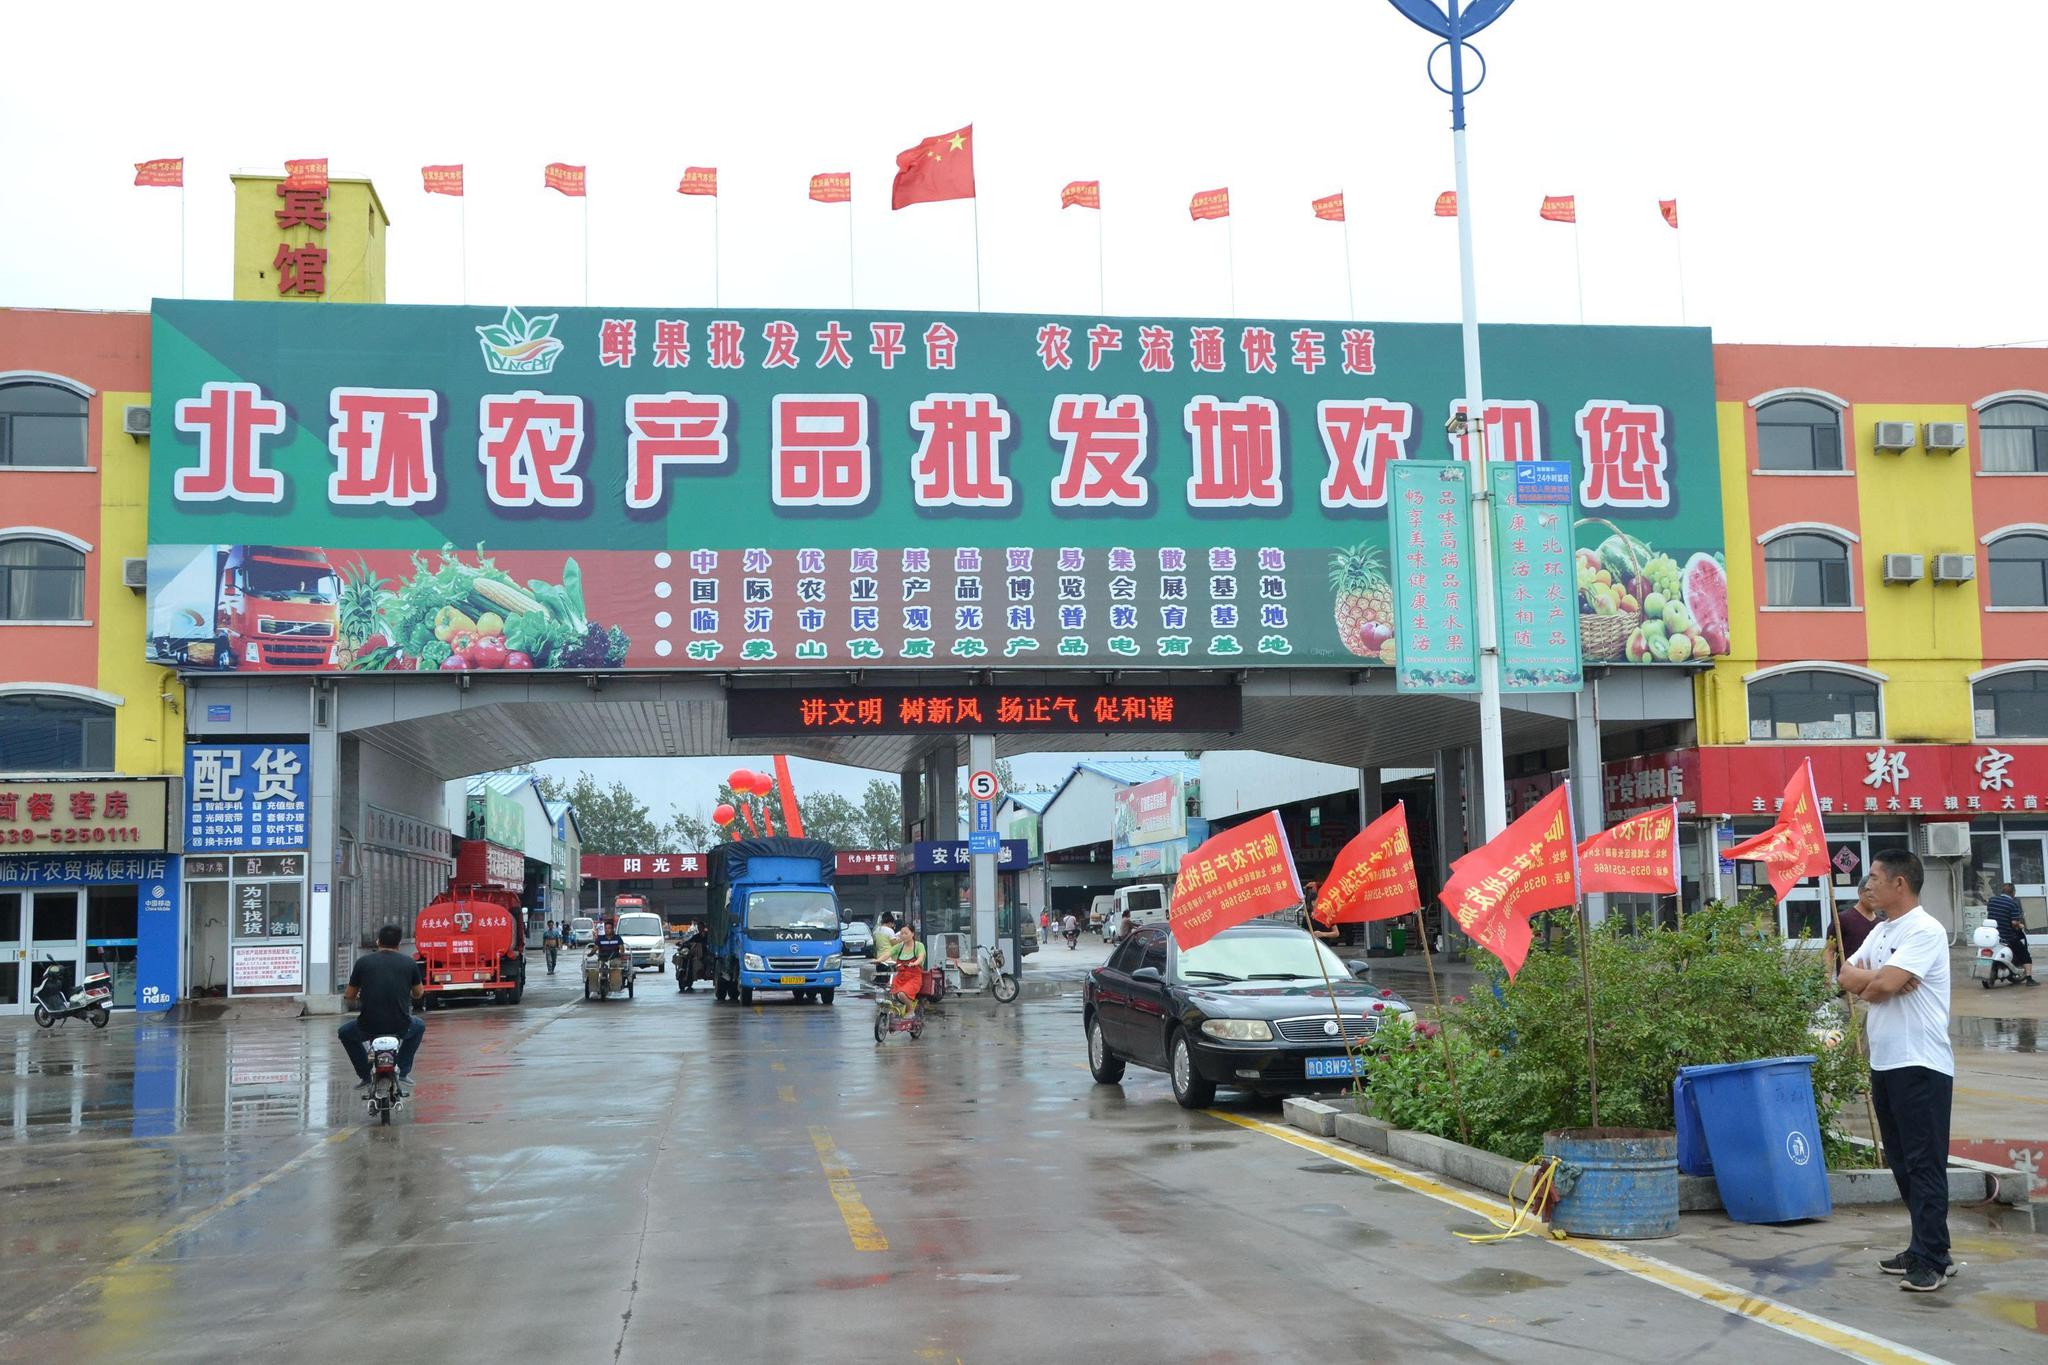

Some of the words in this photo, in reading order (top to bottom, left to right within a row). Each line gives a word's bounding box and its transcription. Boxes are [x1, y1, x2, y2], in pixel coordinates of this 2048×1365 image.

[273, 184, 329, 297] 宾馆
[598, 318, 959, 370] 鲜果批发大平台
[1035, 322, 1377, 376] 农产流通快车道
[690, 547, 1286, 573] 中外优质果品贸易集散基地
[1404, 489, 1431, 651] 畅享美味健康生活
[1437, 491, 1464, 651] 品味高端品质水果
[1542, 502, 1567, 646] 沂北环农产品
[691, 576, 1287, 603] 国际农业产品博览会展基地
[690, 604, 1288, 632] 临沂市民观光科普教育基地
[686, 635, 1292, 660] 沂蒙山优质农产品电商基地
[800, 697, 883, 725] 讲文明
[899, 697, 982, 725] 树新风
[997, 696, 1079, 724] 扬正气
[1093, 696, 1174, 723] 促和谐
[192, 748, 301, 802] 配货
[977, 778, 990, 793] 5
[69, 790, 129, 820] 客房
[205, 802, 243, 811] 智能手机
[267, 801, 304, 811] 充值缴费
[1752, 796, 1848, 812] 主要营：
[1864, 796, 1923, 811] 黑木耳
[1944, 795, 1981, 811] 银耳
[2001, 795, 2048, 810] 大茴
[266, 824, 304, 834] 软件下载
[267, 812, 304, 822] 套餐办理
[266, 836, 304, 846] 手机上网
[623, 857, 699, 873] 阳光果
[932, 846, 1013, 864] 安保勤
[0, 858, 167, 882] 临沂农贸城便利店
[242, 886, 263, 935] 为车找货
[271, 921, 299, 935] 咨询
